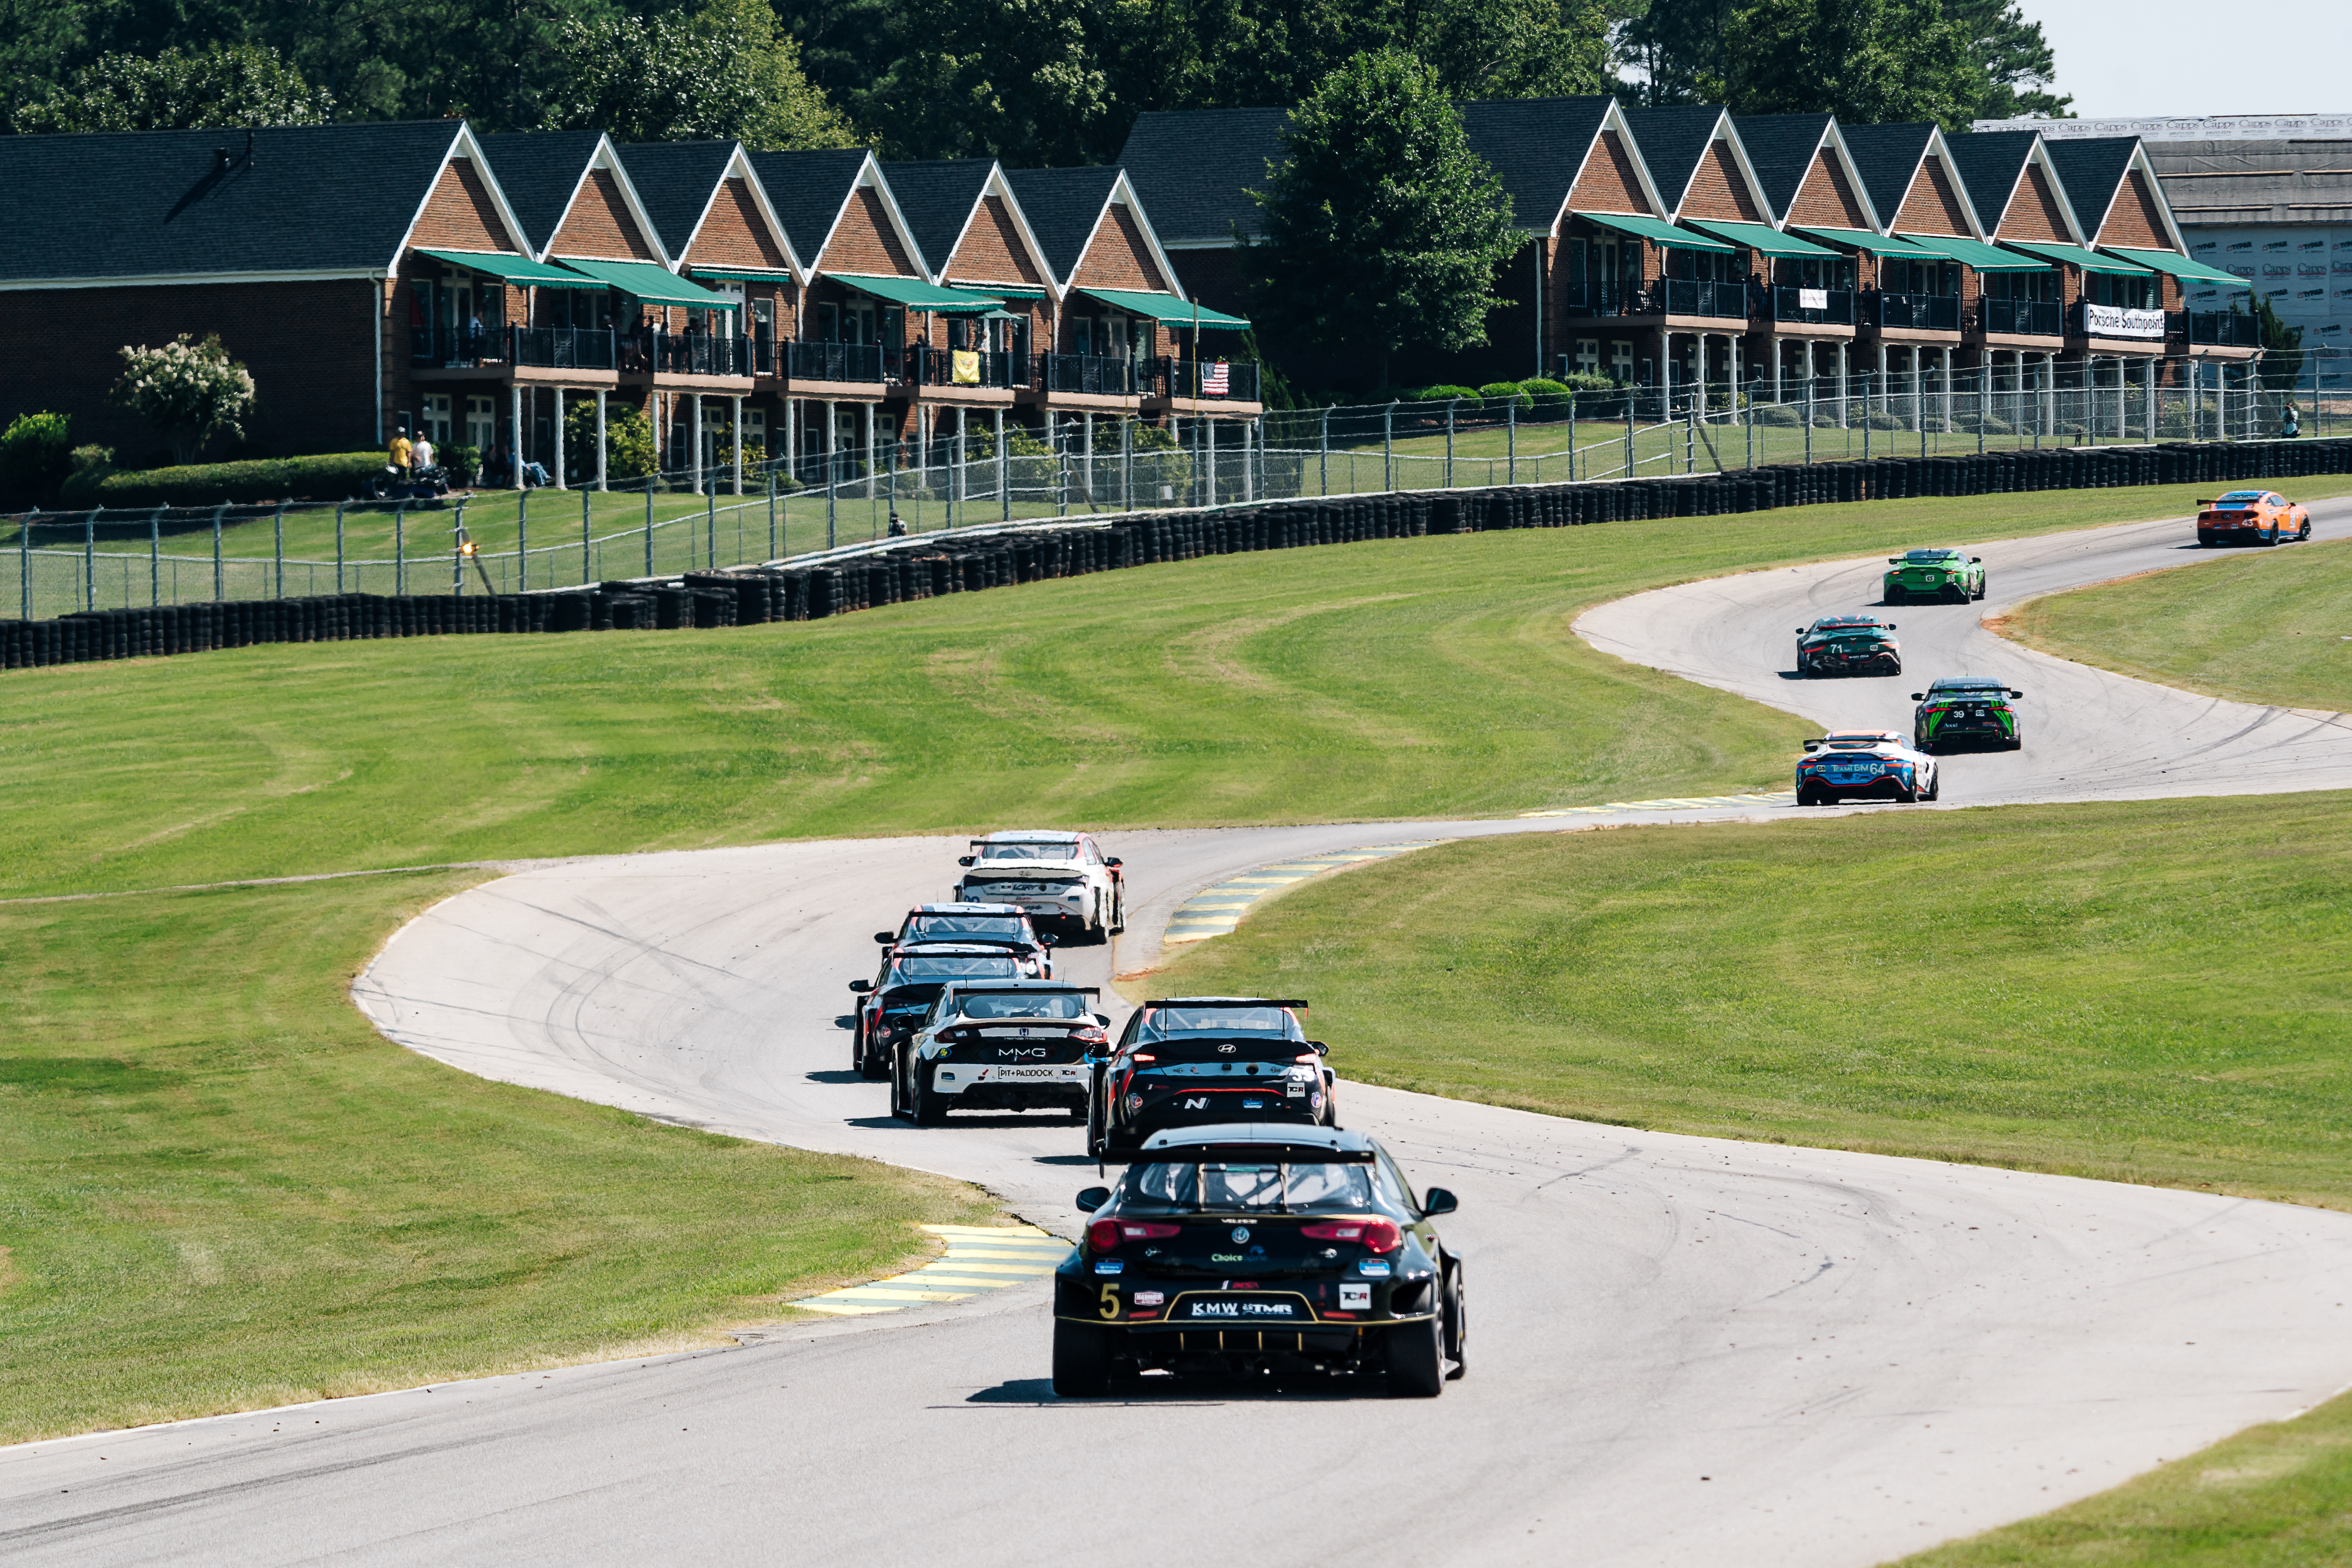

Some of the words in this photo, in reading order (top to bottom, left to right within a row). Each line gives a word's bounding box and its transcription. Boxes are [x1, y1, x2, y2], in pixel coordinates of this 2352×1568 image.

[2058, 123, 2091, 132] Capps
[2095, 122, 2127, 131] Capps
[2131, 122, 2163, 131] Capps
[2166, 120, 2199, 129] Capps
[2203, 120, 2235, 129] Capps
[2239, 119, 2272, 128] Capps
[2274, 119, 2307, 129] Capps
[2311, 118, 2343, 128] Capps
[2196, 242, 2217, 251] TYPAR
[2231, 241, 2252, 250] TYPAR
[2267, 241, 2288, 250] TYPAR
[2302, 241, 2323, 250] TYPAR
[2227, 264, 2256, 275] Capps
[2262, 264, 2291, 275] Capps
[2297, 263, 2327, 275] Capps
[2196, 290, 2217, 299] TYPAR
[2267, 288, 2288, 297] TYPAR
[2302, 288, 2323, 297] TYPAR
[2089, 309, 2119, 328] Porsche
[2122, 313, 2164, 332] Southpoint
[1831, 644, 1842, 653] 71
[1869, 763, 1886, 775] 64
[998, 1048, 1045, 1057] MMG
[1099, 1283, 1120, 1318] 5
[1343, 1291, 1368, 1301] TCR
[1193, 1303, 1238, 1314] KMW
[1252, 1304, 1292, 1313] TMR
